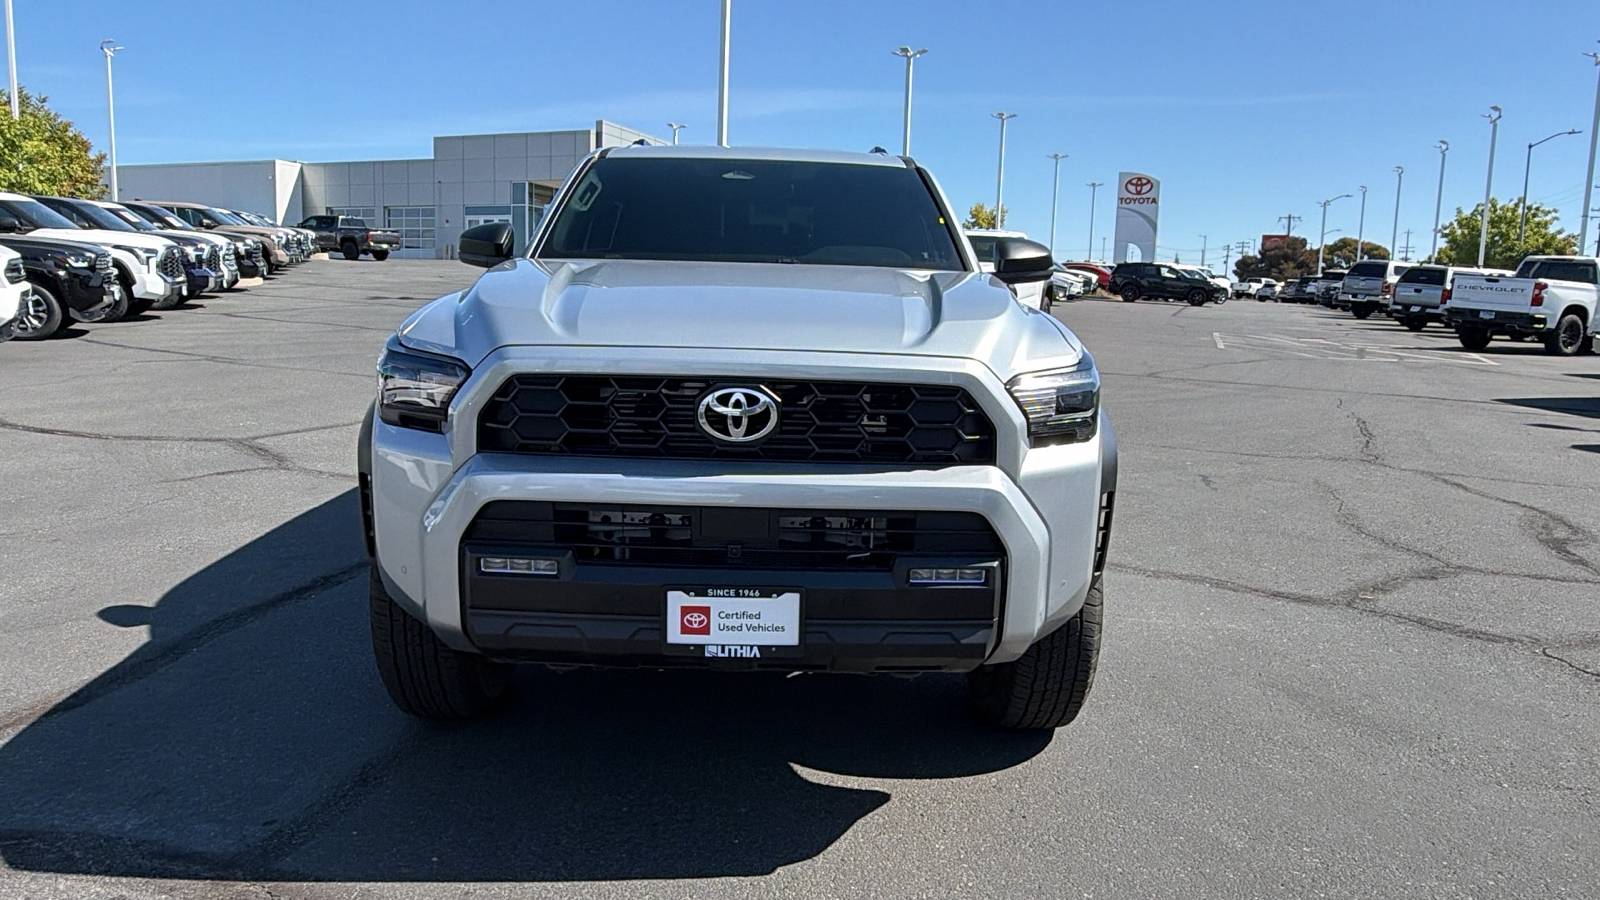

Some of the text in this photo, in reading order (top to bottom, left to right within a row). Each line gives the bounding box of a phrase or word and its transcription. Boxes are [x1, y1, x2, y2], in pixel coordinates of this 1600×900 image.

[1119, 197, 1157, 205] TOYOTA
[1457, 284, 1527, 293] CHEVROLET
[707, 588, 760, 597] SINCE 1946
[718, 610, 761, 620] Certified
[718, 623, 785, 632] Used Vehicles
[717, 645, 761, 658] LITHIA
